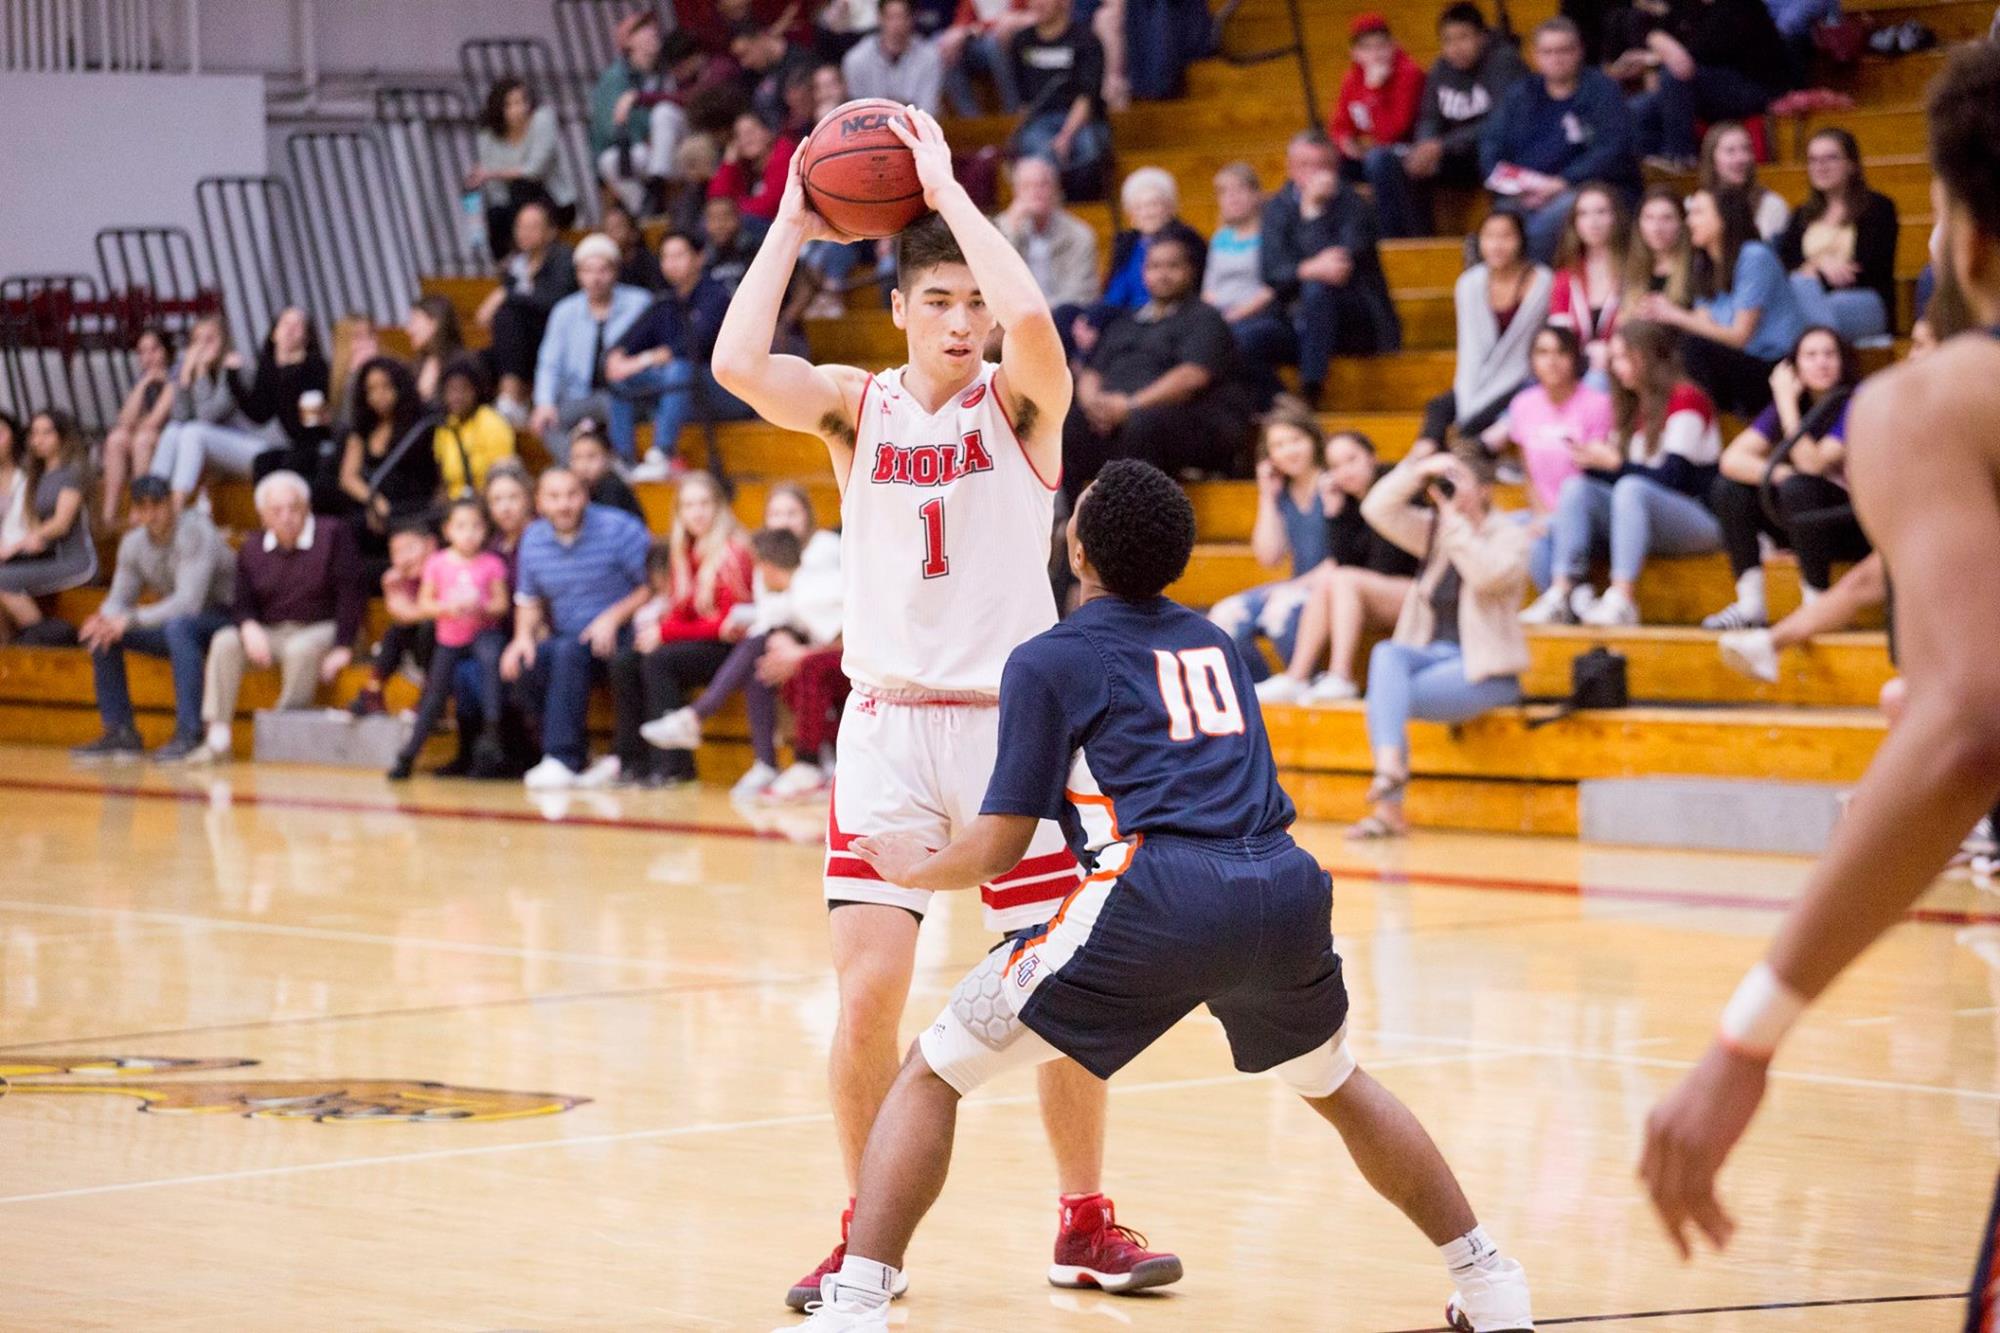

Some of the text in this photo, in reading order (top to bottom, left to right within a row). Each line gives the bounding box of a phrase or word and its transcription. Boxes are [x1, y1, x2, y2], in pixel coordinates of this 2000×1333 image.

[871, 429, 994, 487] BIOLA
[919, 497, 949, 579] 1
[1152, 645, 1246, 741] 10
